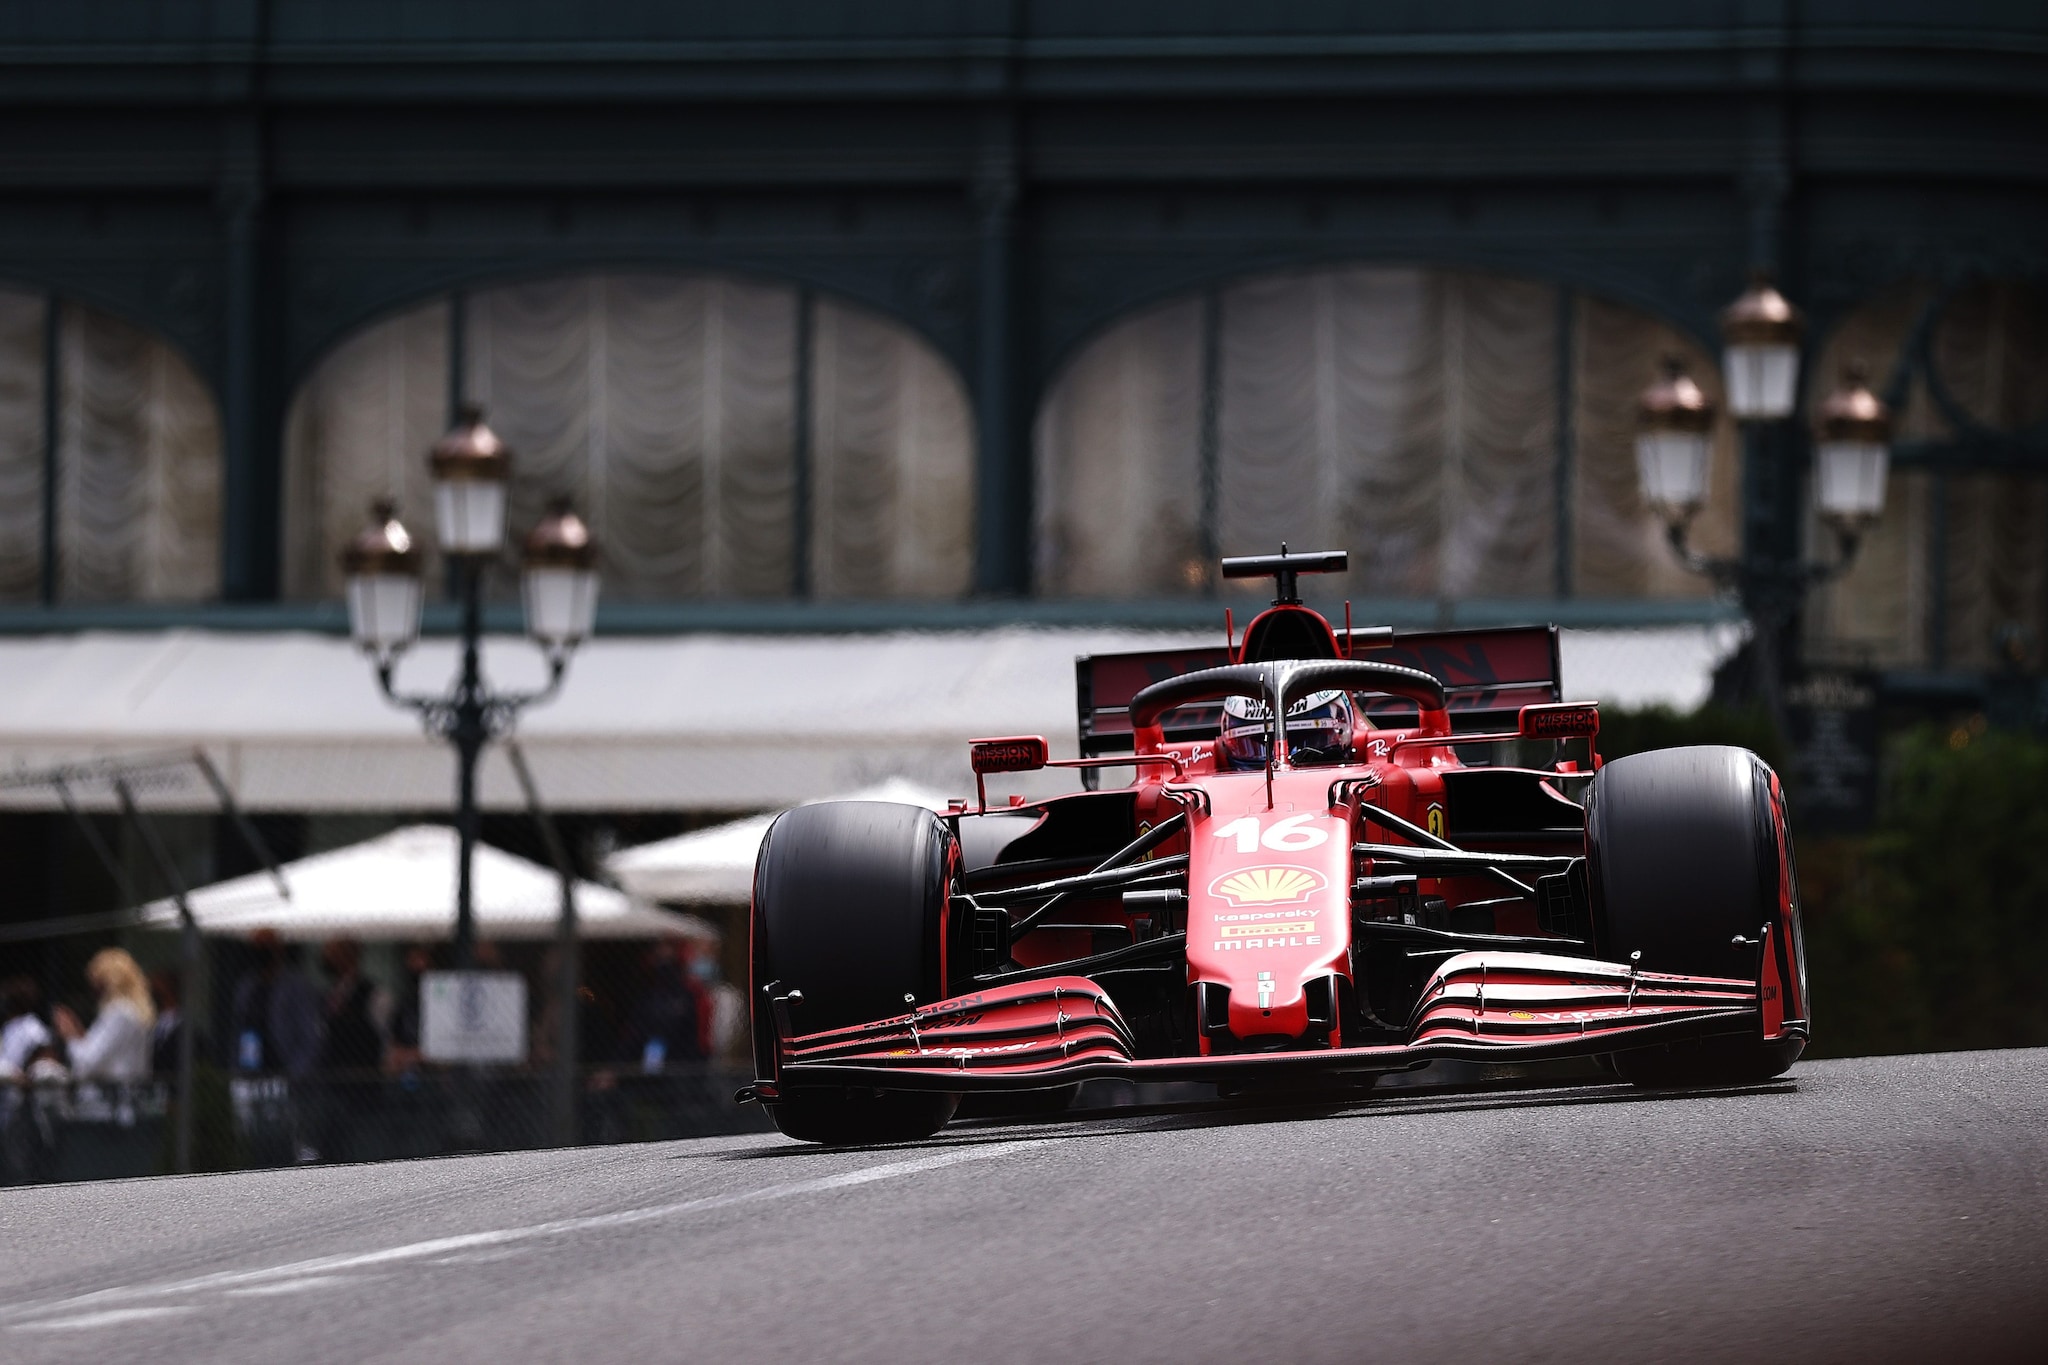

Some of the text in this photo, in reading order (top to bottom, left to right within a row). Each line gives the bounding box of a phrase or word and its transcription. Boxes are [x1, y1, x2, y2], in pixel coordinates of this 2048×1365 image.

[1536, 712, 1594, 724] MISSION
[1536, 723, 1596, 734] WINNOW
[975, 745, 1032, 757] MISSION
[975, 756, 1032, 768] WINNOW
[1213, 814, 1329, 853] 16
[1214, 909, 1321, 922] kaspersky
[1214, 935, 1321, 951] MAHLE
[1539, 1006, 1663, 1020] V-Power
[920, 1041, 1038, 1055] V-Power
